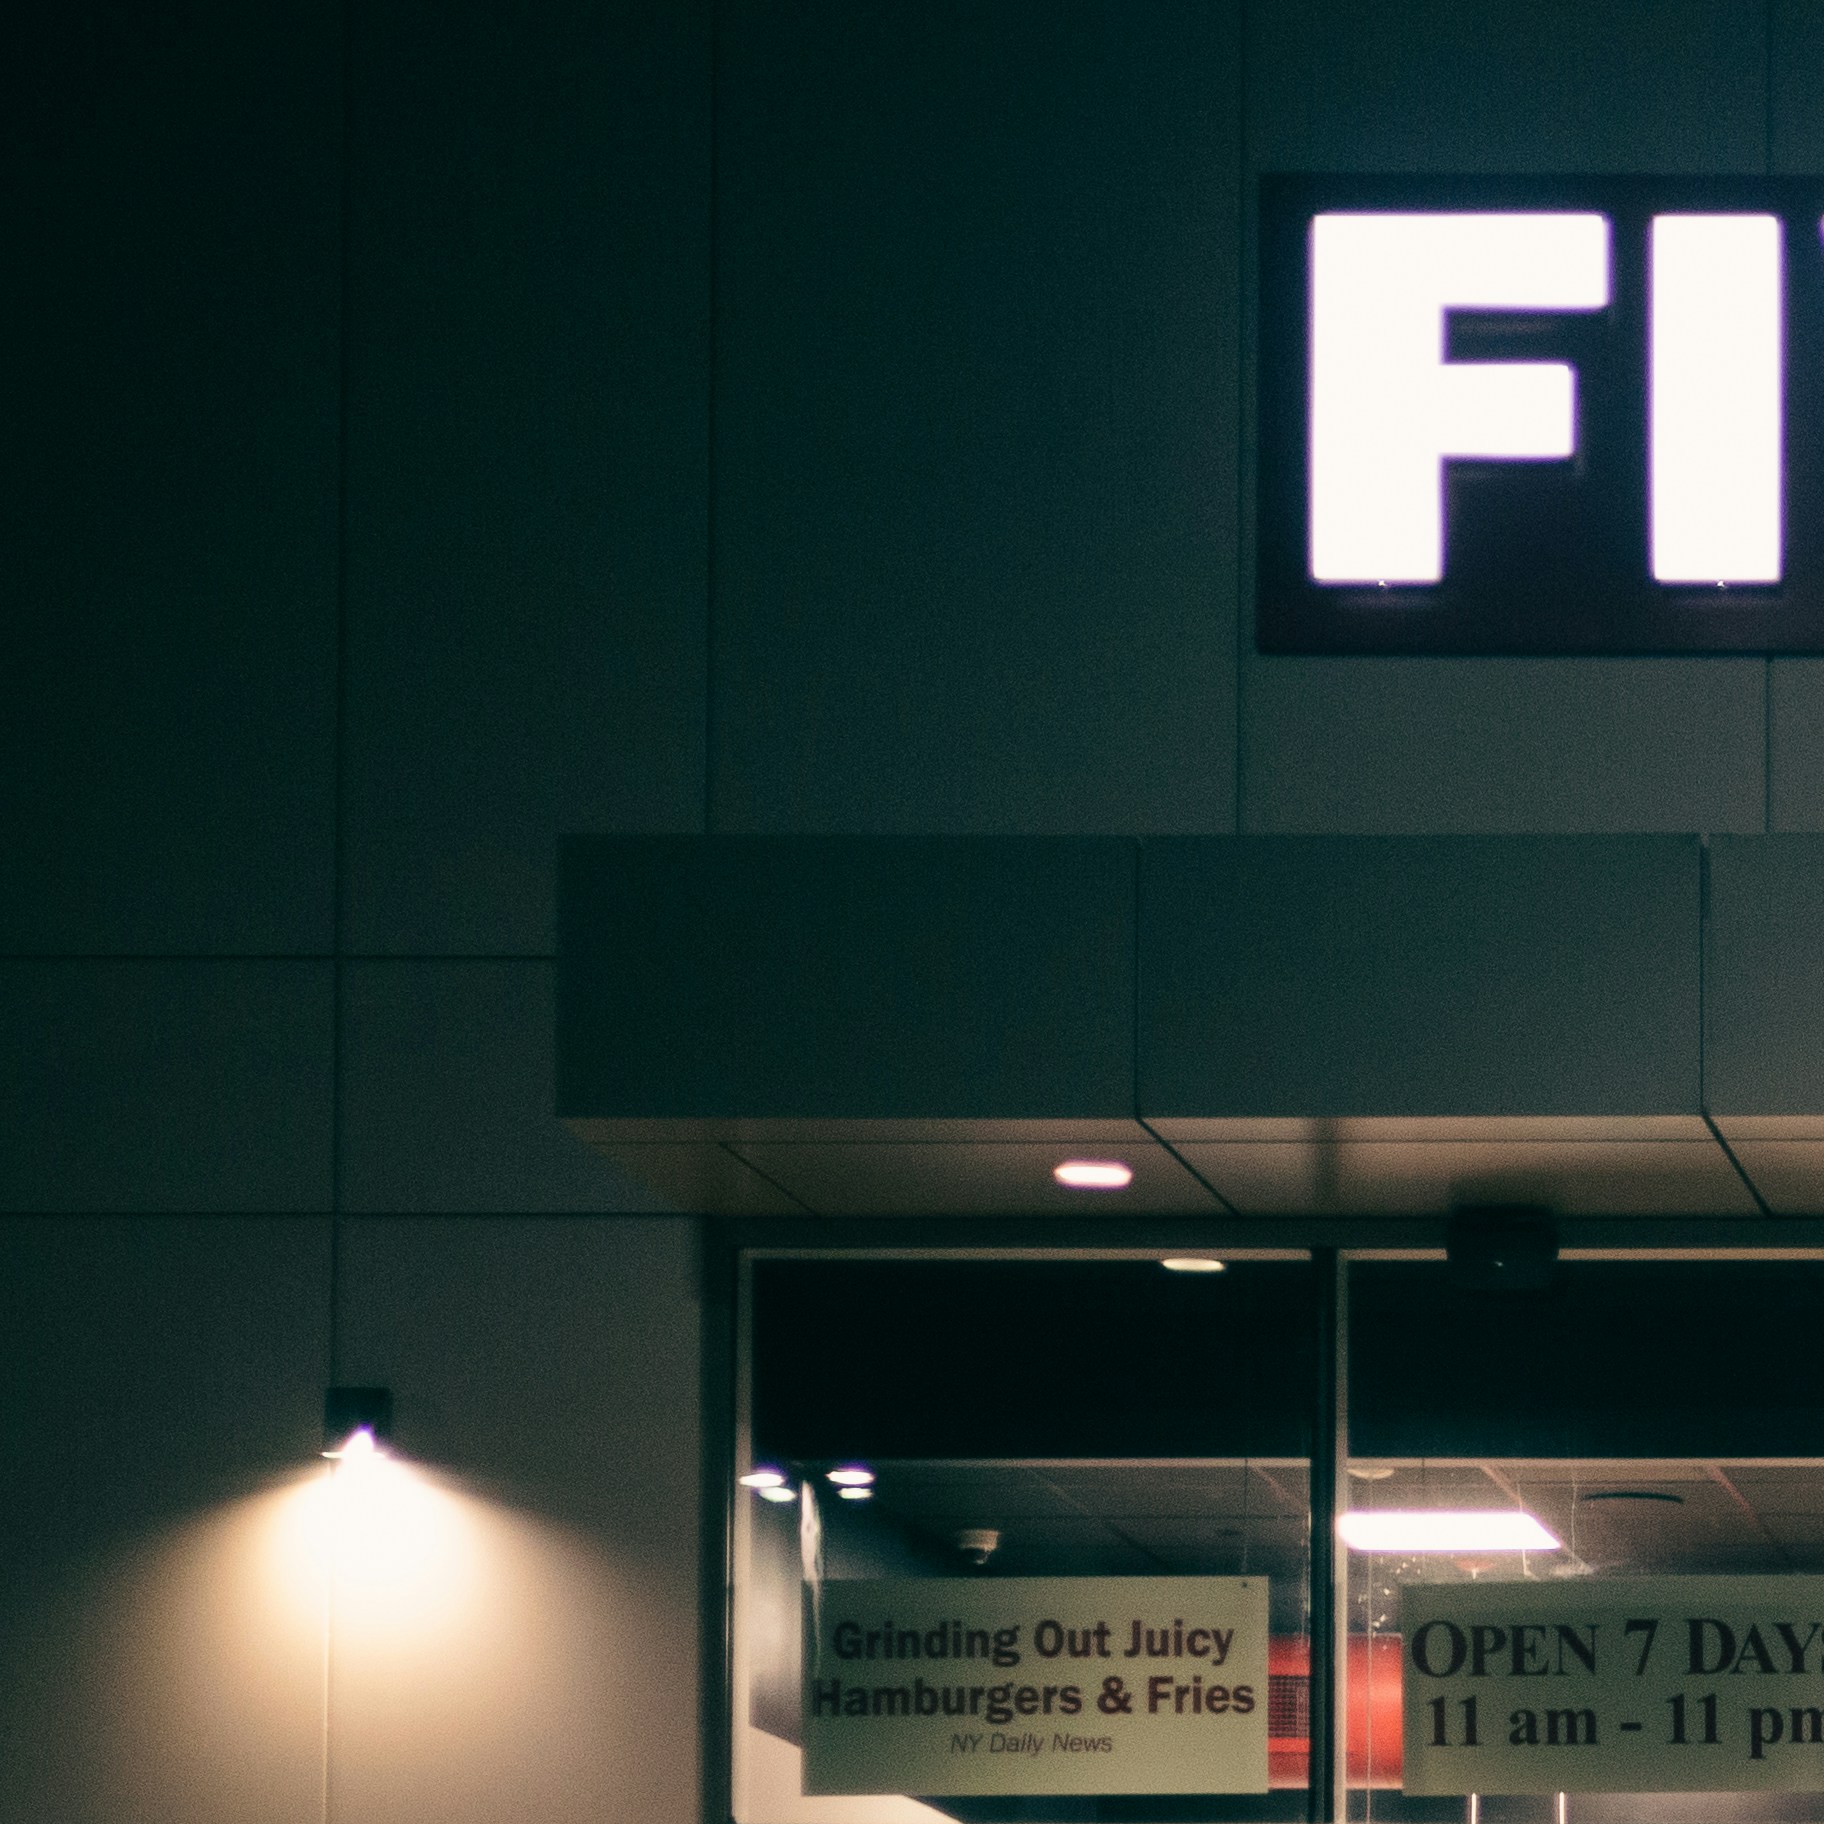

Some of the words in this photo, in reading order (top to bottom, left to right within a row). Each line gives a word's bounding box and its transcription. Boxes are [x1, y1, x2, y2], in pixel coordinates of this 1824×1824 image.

[832, 1619, 1020, 1668] Grinding
[1033, 1619, 1112, 1659] Out
[1123, 1618, 1234, 1666] Juicy
[1410, 1619, 1600, 1678] OPEN
[1623, 1618, 1658, 1676] 7
[809, 1676, 1083, 1724] Hamburgers
[1096, 1675, 1133, 1716] &
[1147, 1675, 1256, 1715] Fries
[1427, 1696, 1482, 1747] 11
[1508, 1706, 1598, 1746] am
[1620, 1721, 1643, 1732] -
[1665, 1692, 1722, 1745] 11
[950, 1733, 984, 1754] NY
[988, 1732, 1044, 1758] Daily
[1052, 1733, 1113, 1754] News
